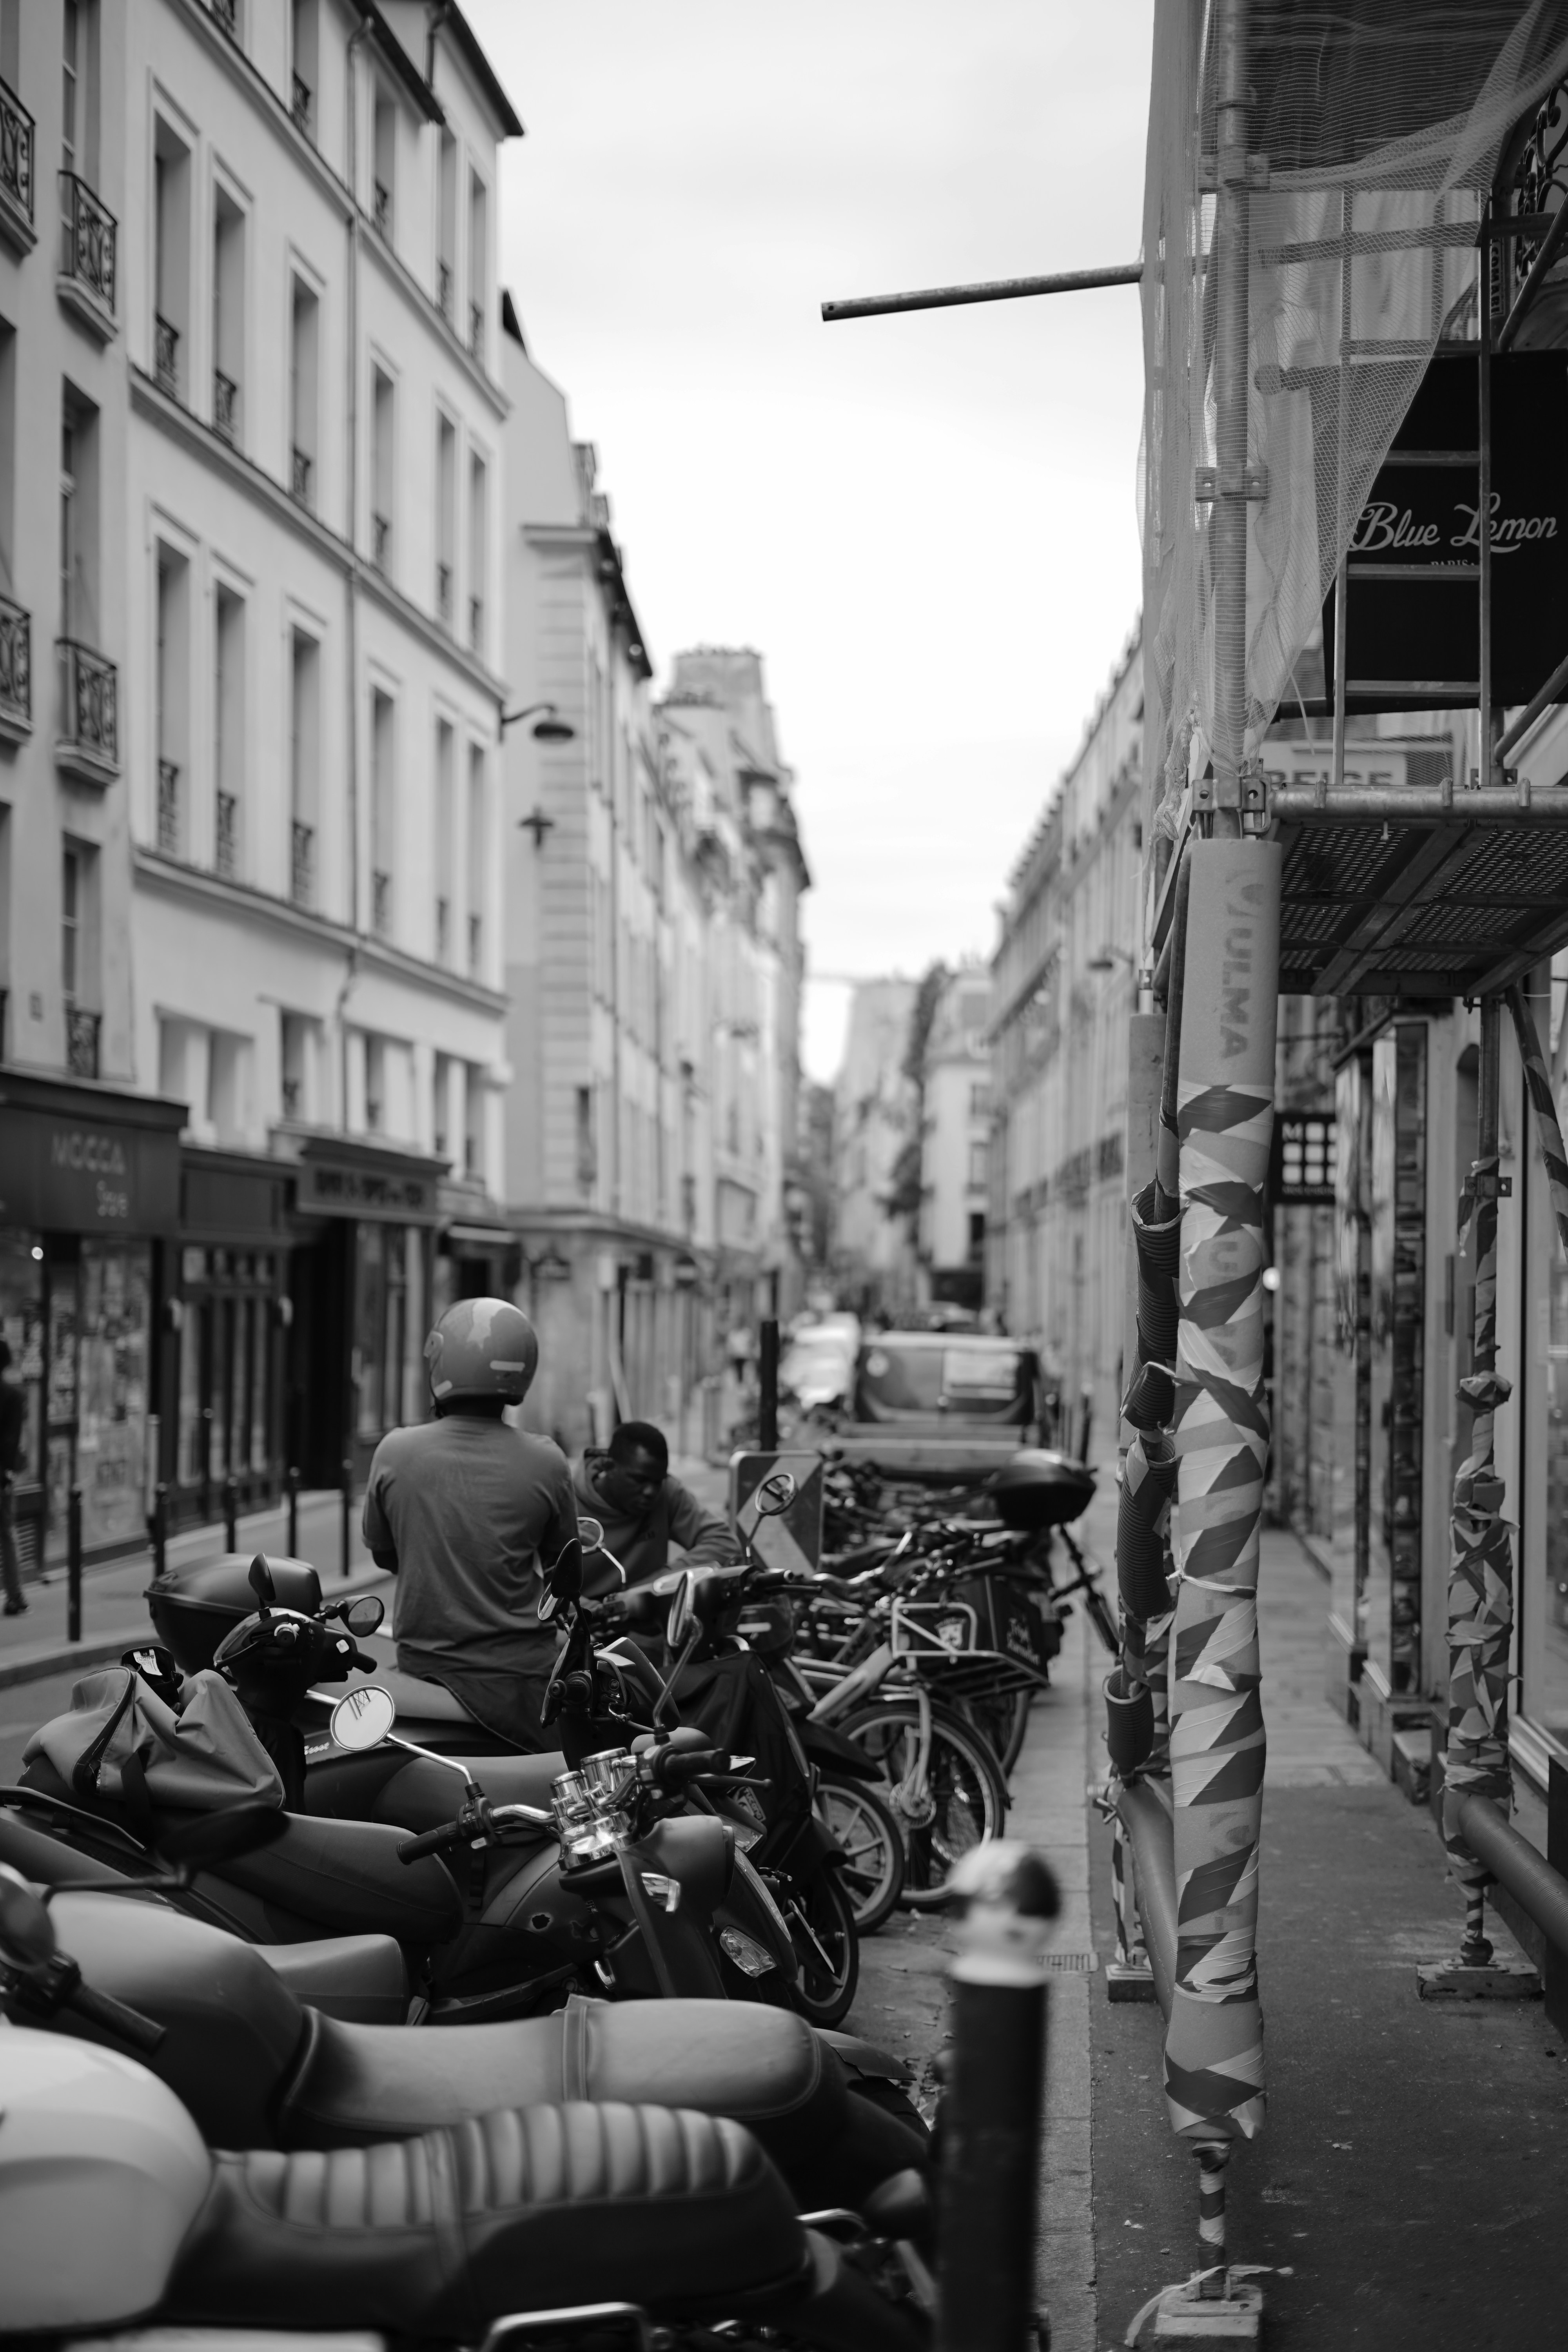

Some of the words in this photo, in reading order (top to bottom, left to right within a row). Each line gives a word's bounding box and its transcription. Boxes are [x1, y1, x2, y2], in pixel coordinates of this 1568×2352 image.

[1348, 502, 1440, 552] Blue
[1450, 492, 1558, 553] Lemon
[1219, 928, 1252, 1059] ULMA
